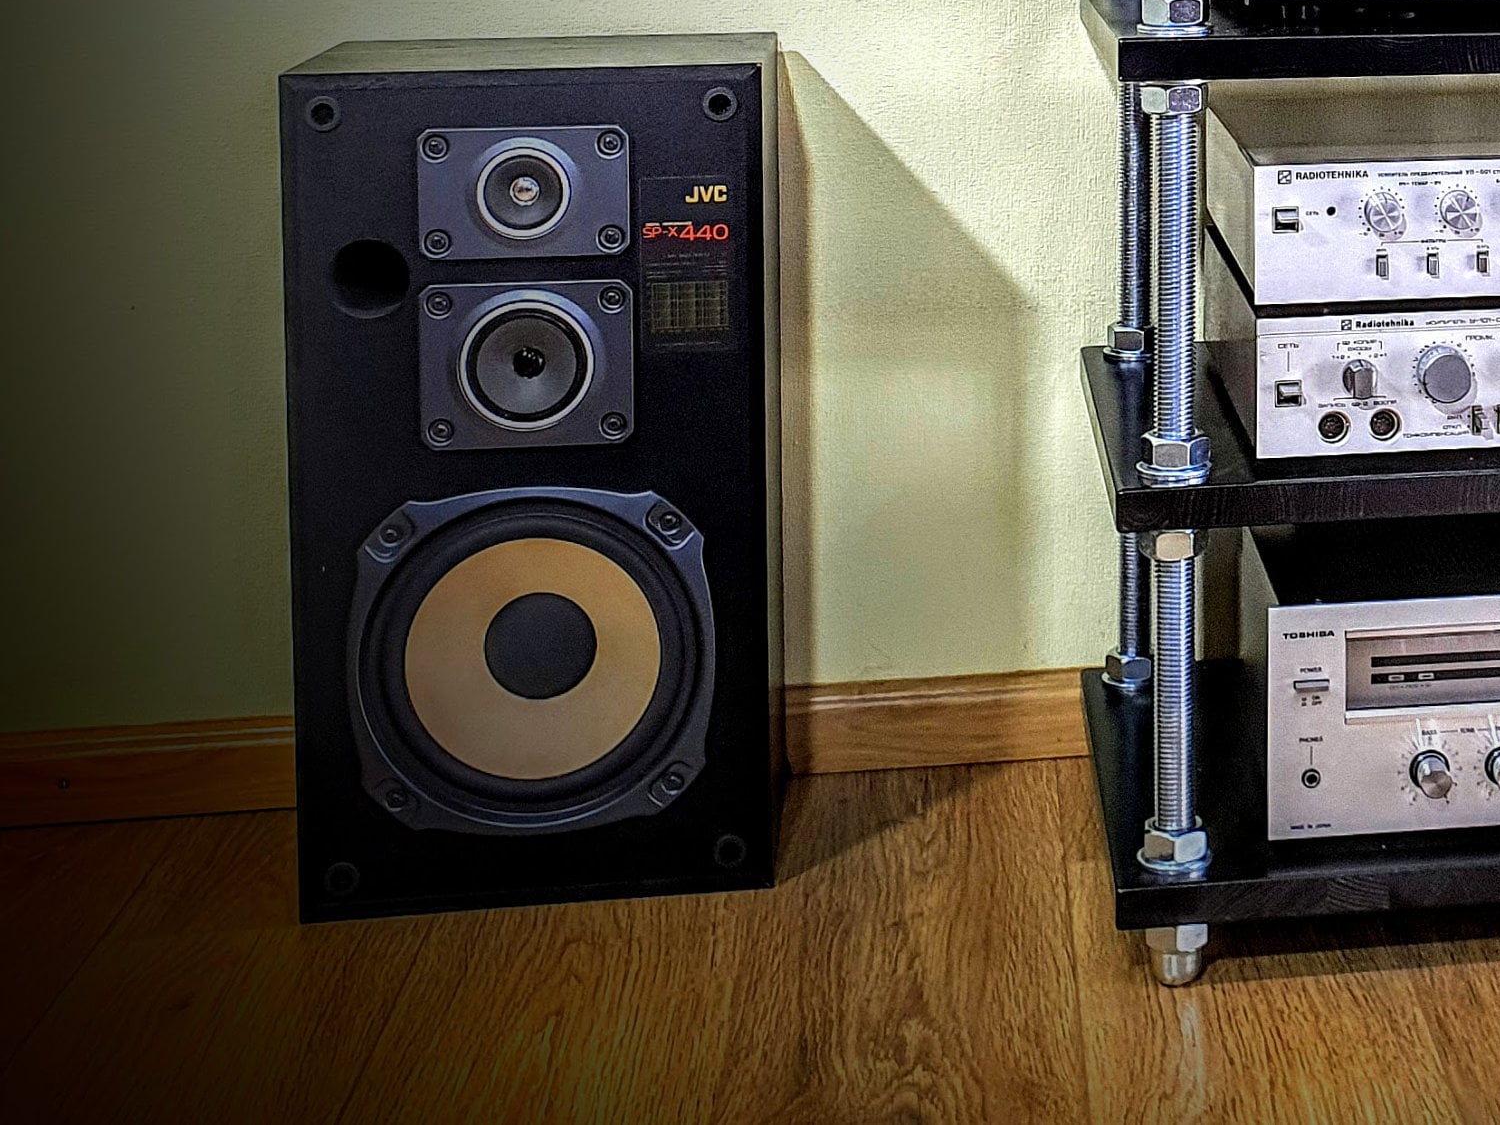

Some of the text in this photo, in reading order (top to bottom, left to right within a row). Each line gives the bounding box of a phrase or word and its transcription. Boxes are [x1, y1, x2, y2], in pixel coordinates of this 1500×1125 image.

[1295, 169, 1369, 180] RADIOTEHNIKA
[685, 185, 728, 203] JVC
[642, 222, 730, 241] SP-X440
[1355, 319, 1415, 329] Radiotehnika
[1282, 630, 1336, 640] TOSHIBA
